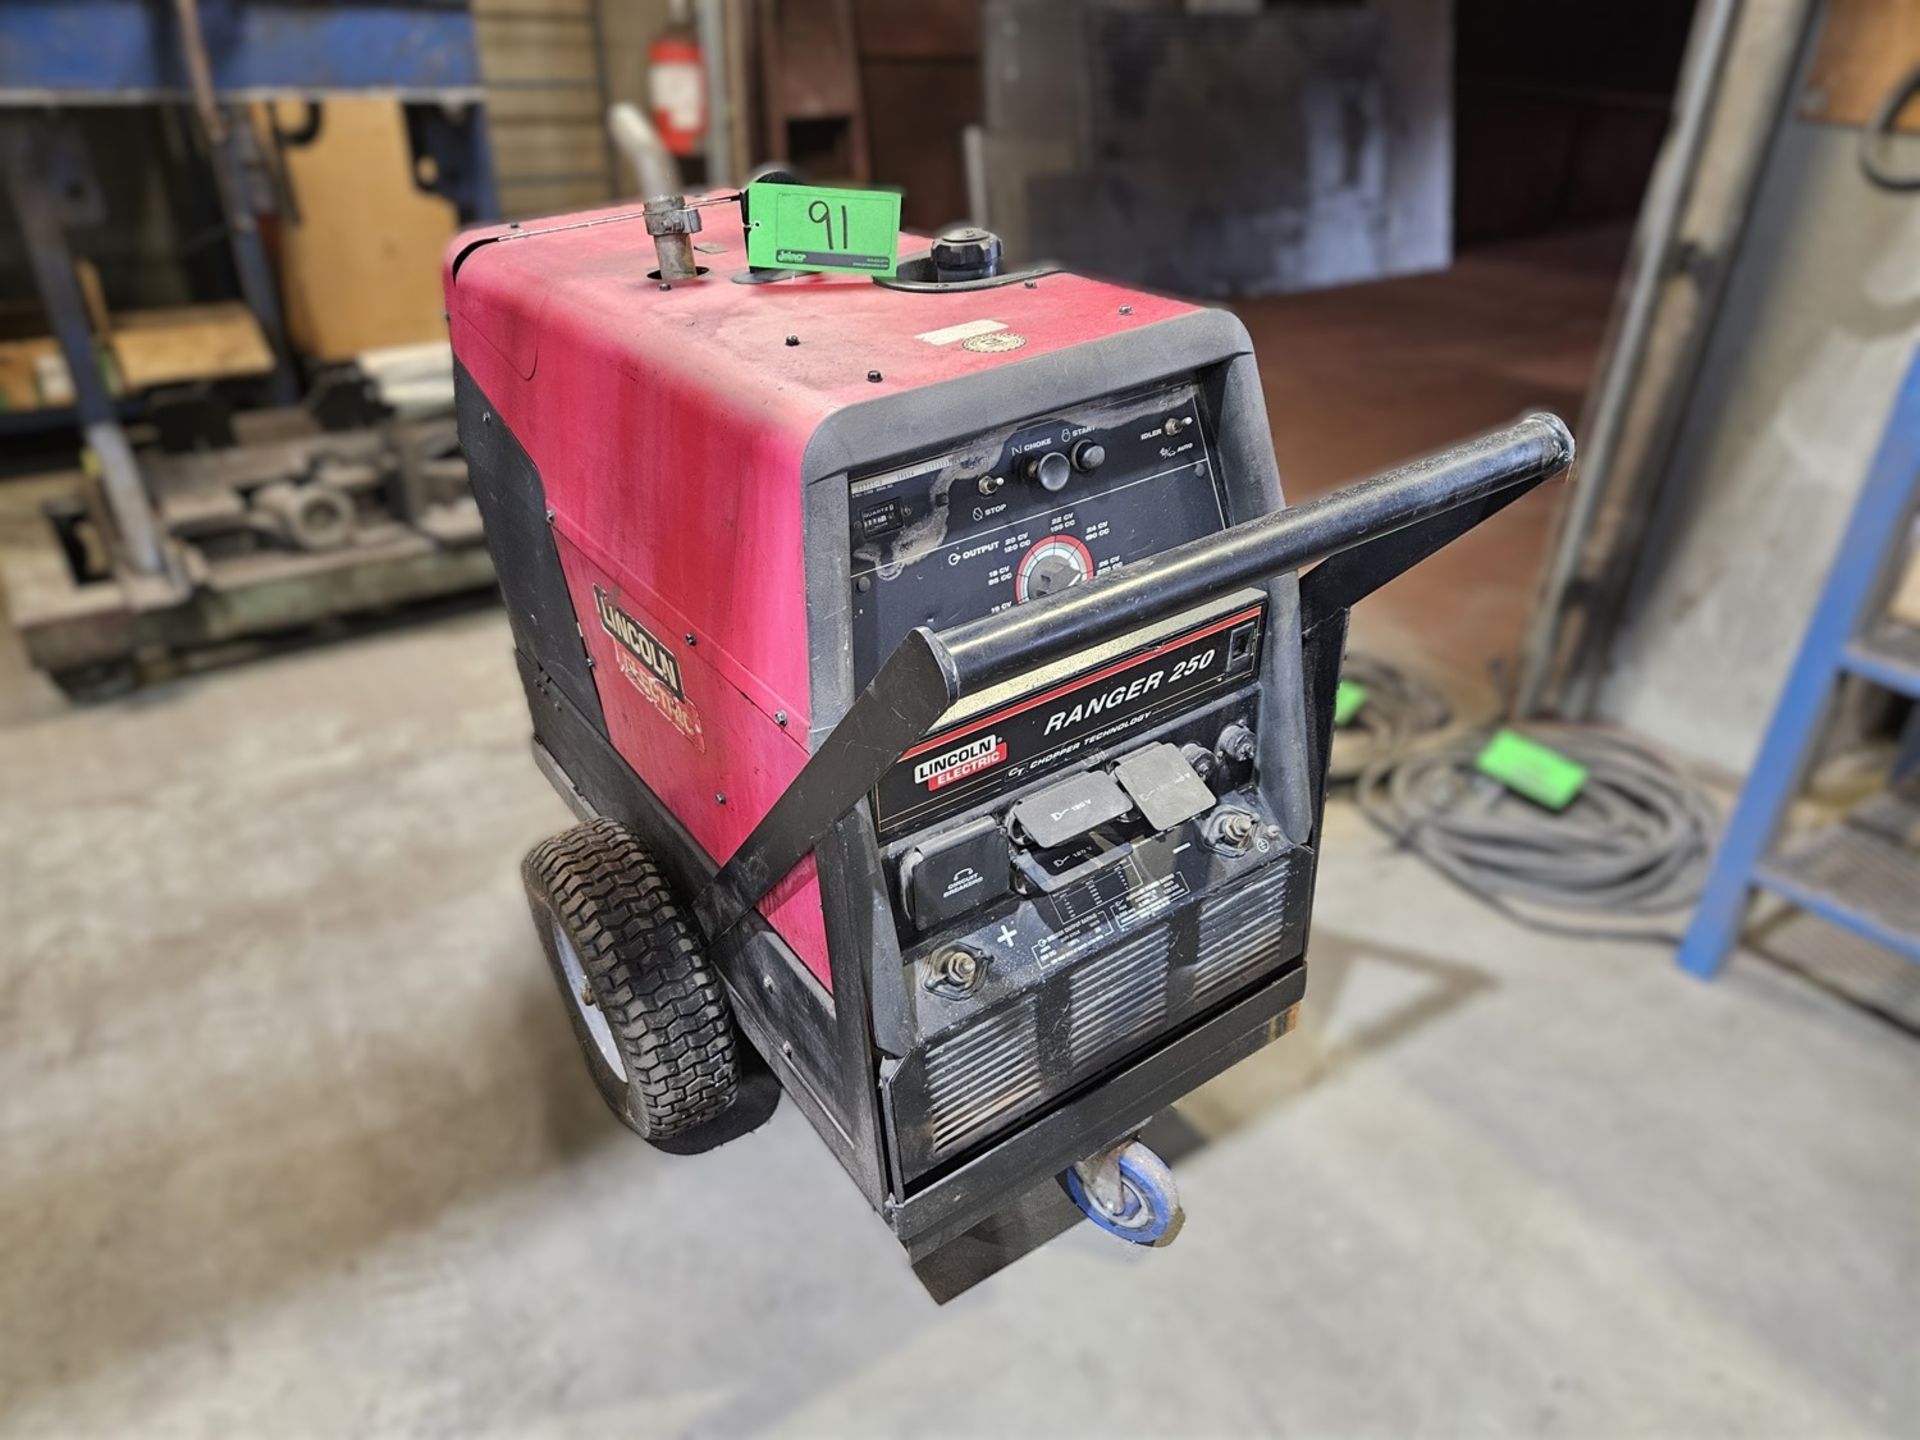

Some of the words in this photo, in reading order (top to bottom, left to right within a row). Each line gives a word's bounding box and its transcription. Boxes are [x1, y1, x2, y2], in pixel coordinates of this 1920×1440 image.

[808, 200, 848, 250] 91
[1072, 426, 1096, 438] START
[1141, 428, 1162, 440] IDLER
[1023, 438, 1052, 452] CHOKE
[984, 503, 1007, 516] STOP
[1063, 512, 1074, 520] CV
[1098, 521, 1108, 529] CV
[1004, 537, 1016, 546] 20
[1017, 532, 1028, 540] CV
[1019, 540, 1031, 548] CC
[962, 541, 1000, 560] OUTPUT
[1110, 555, 1120, 564] CV
[999, 565, 1010, 574] CV
[1000, 572, 1012, 581] CC
[1001, 601, 1012, 610] CV
[599, 597, 679, 691] LINCOLN
[1043, 670, 1165, 736] RANGER
[1167, 648, 1216, 684] 250
[1030, 742, 1081, 769] CHOPPER
[1083, 710, 1152, 746] TECHNOLOGY
[919, 739, 992, 779] LINCOLN
[937, 751, 1001, 785] ELECTRIC
[943, 876, 984, 898] BREAKERS
[948, 872, 978, 890] CIRCUIT
